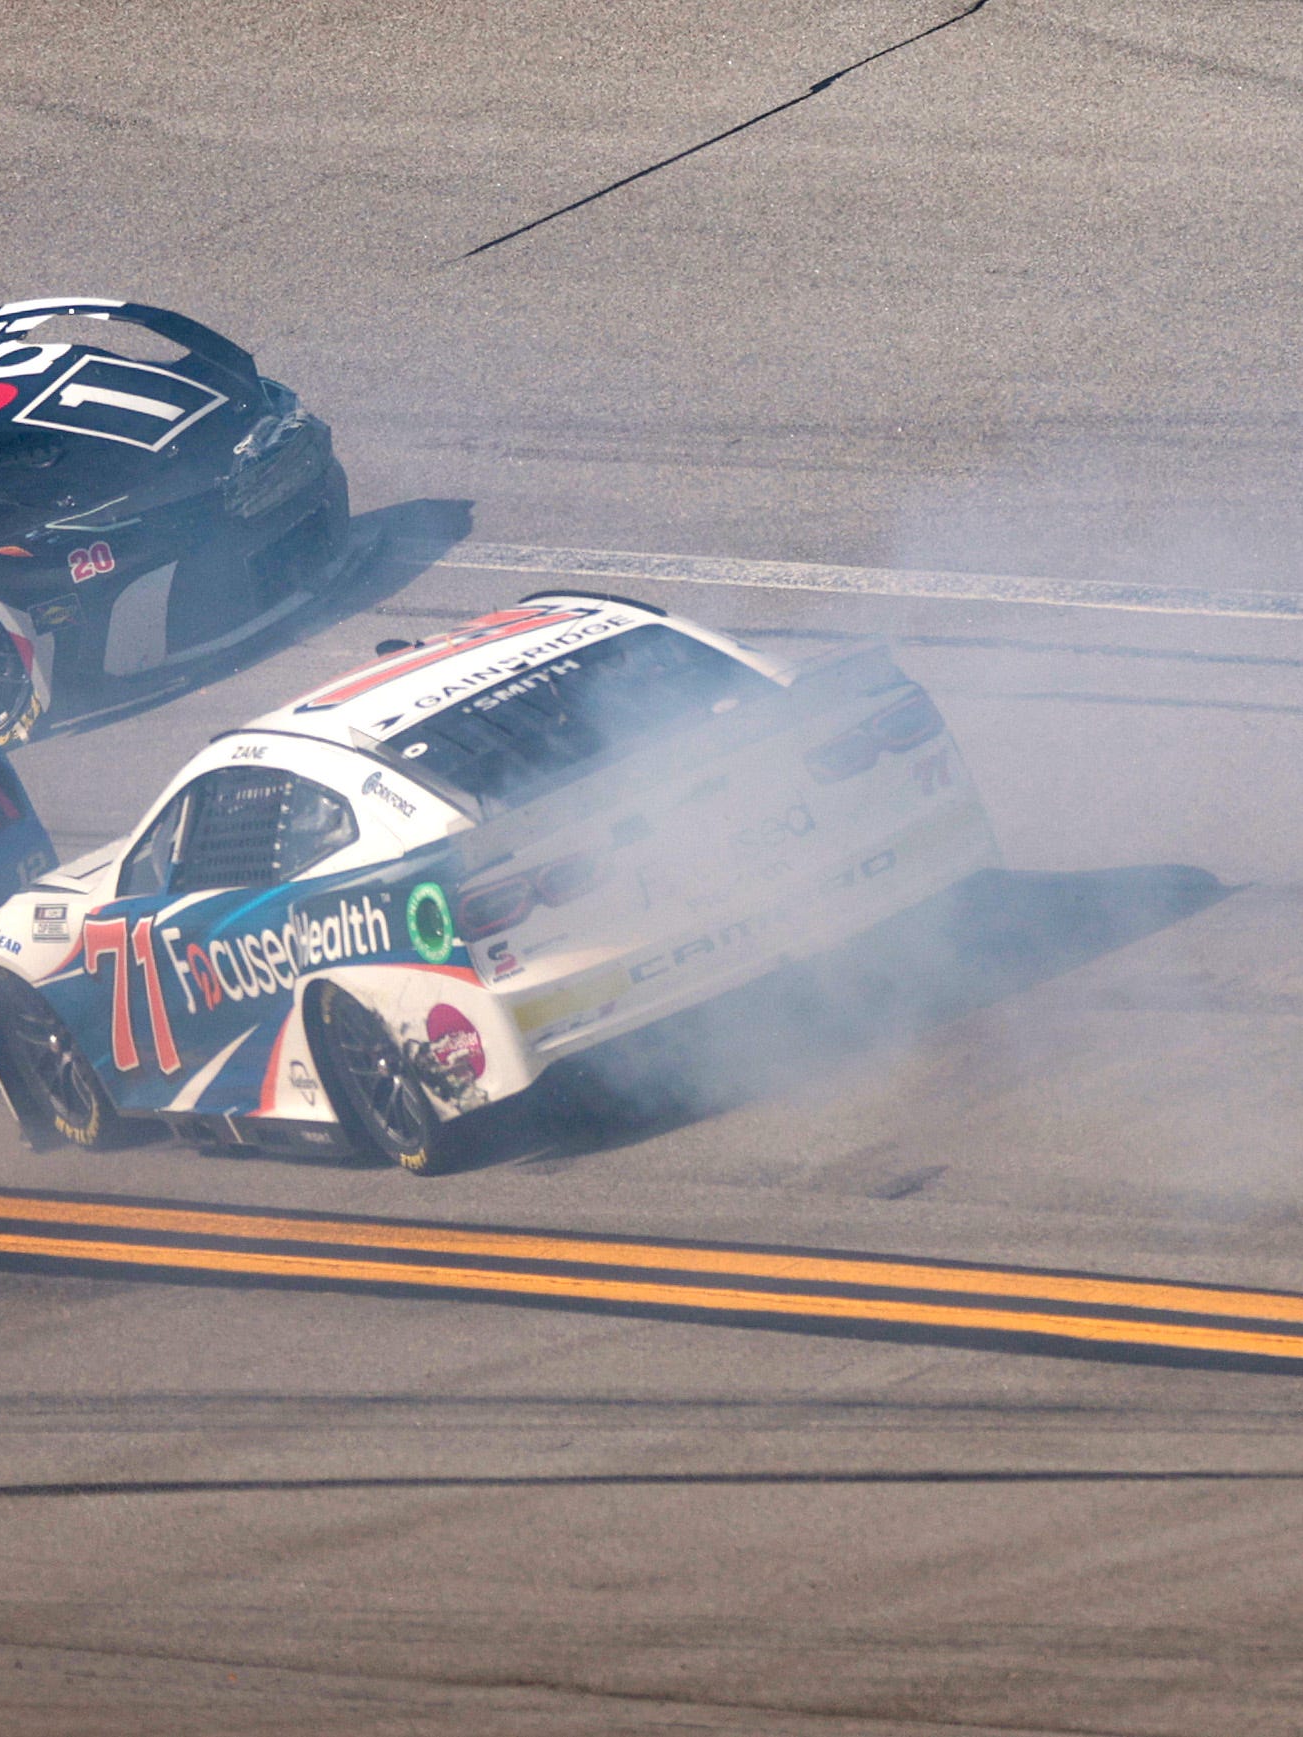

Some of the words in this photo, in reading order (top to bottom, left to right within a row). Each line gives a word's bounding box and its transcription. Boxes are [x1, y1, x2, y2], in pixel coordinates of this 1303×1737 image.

[58, 382, 186, 422] 1
[68, 541, 115, 584] 20
[83, 913, 182, 1076] 71
